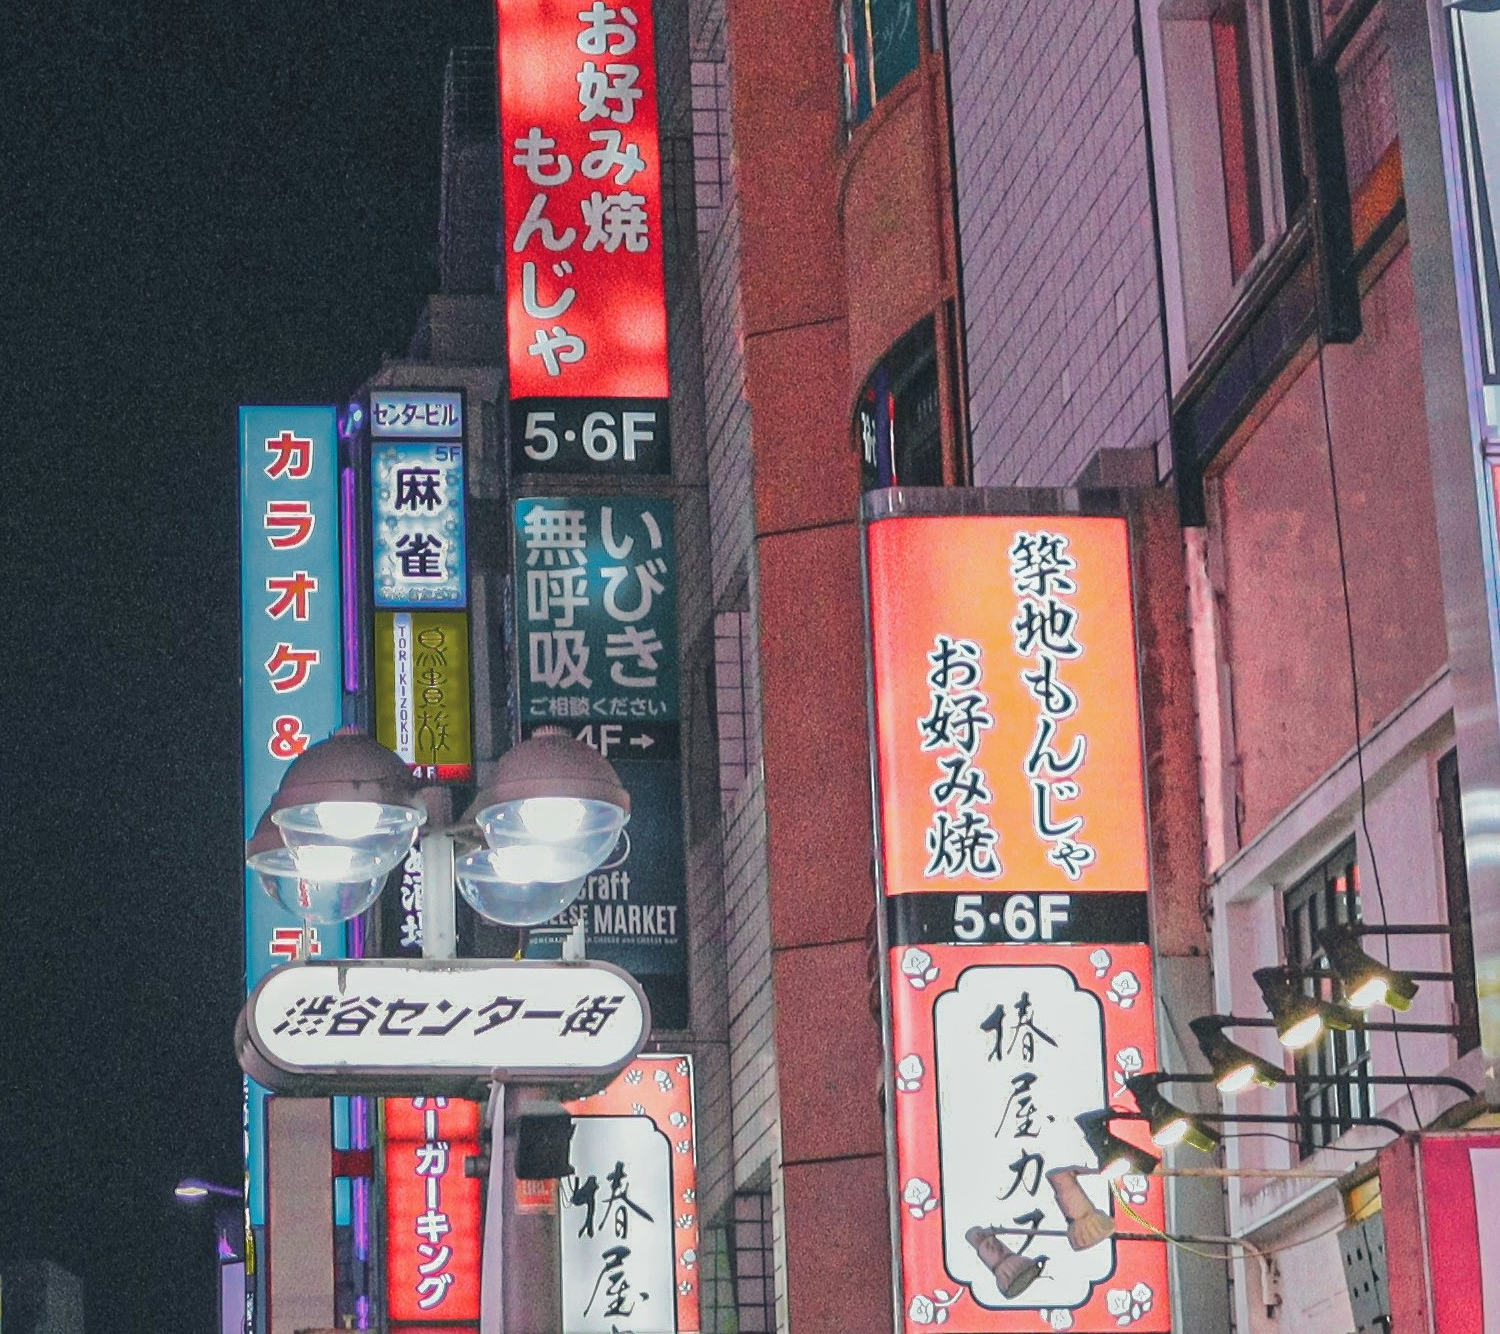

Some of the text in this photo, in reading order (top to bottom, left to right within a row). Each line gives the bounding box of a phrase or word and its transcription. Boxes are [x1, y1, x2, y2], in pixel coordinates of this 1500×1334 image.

[575, 0, 650, 254] お好み焼
[512, 127, 586, 377] もんじゃ
[373, 403, 460, 427] センタービル
[435, 445, 461, 463] 5F
[393, 464, 447, 581] 麻雀
[523, 505, 593, 691] 無呼吸
[599, 505, 668, 688] いびき
[396, 625, 409, 747] TORIKIZOKU
[529, 696, 669, 717] ご相談ください
[1008, 531, 1096, 879] 築地もんじゃ
[918, 634, 1001, 878] お好み焼
[593, 904, 678, 936] MARKET
[271, 994, 627, 1038] 渋谷センター街
